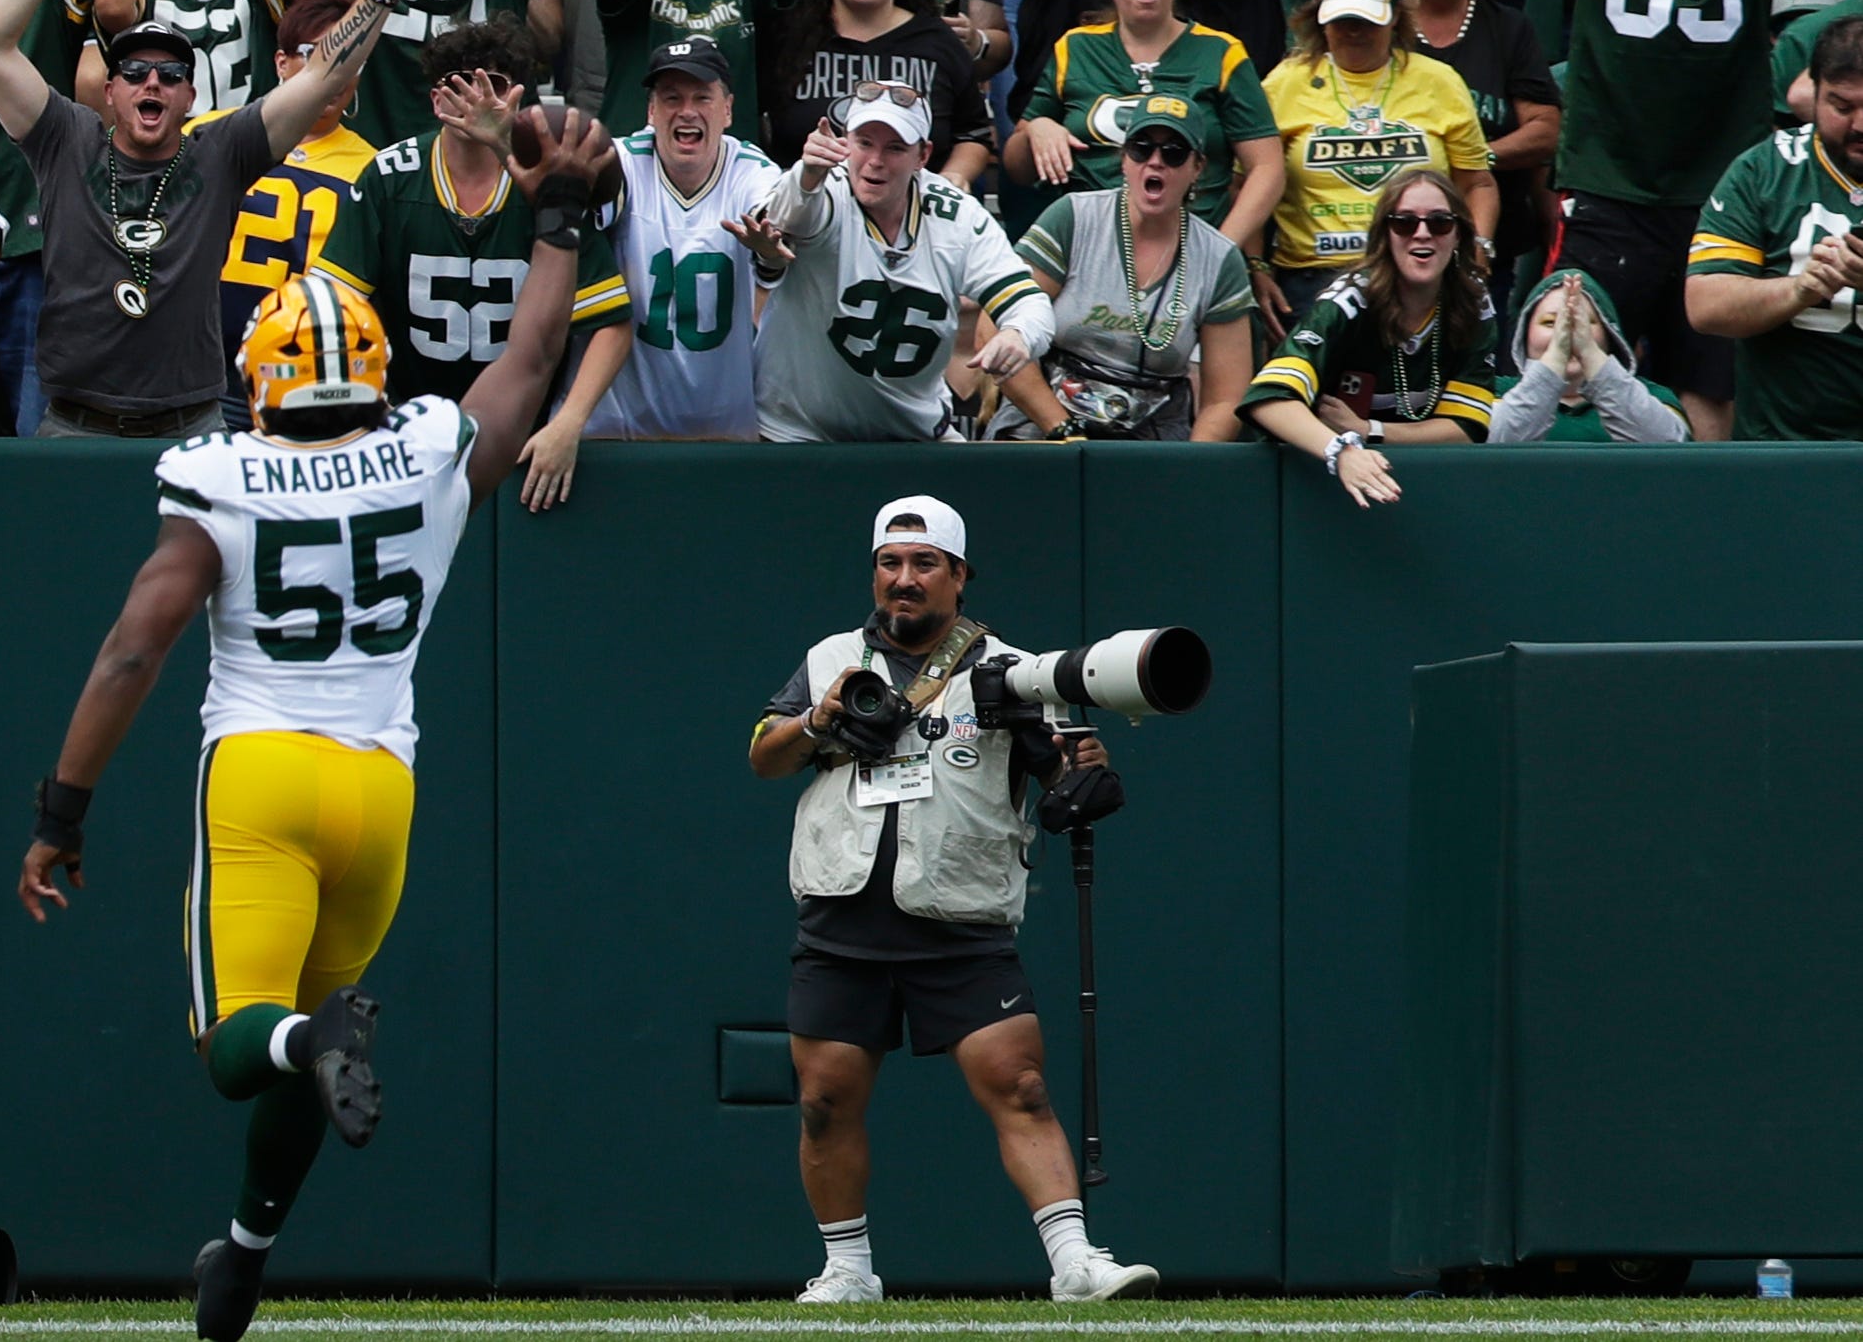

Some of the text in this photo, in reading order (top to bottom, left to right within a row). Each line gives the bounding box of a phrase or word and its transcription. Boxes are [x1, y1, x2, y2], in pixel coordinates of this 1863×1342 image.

[1146, 96, 1188, 119] GB
[1313, 135, 1423, 160] DRAFT
[113, 216, 166, 252] G
[221, 176, 339, 288] 21
[1319, 235, 1364, 252] BUD
[113, 279, 148, 316] G
[408, 254, 532, 362] 52
[638, 247, 736, 354] 10
[827, 279, 949, 378] 26
[313, 388, 352, 401] PACKERS
[242, 445, 425, 495] ENAGBARE
[253, 502, 427, 662] 55
[953, 722, 978, 740] NFL
[941, 743, 981, 769] G
